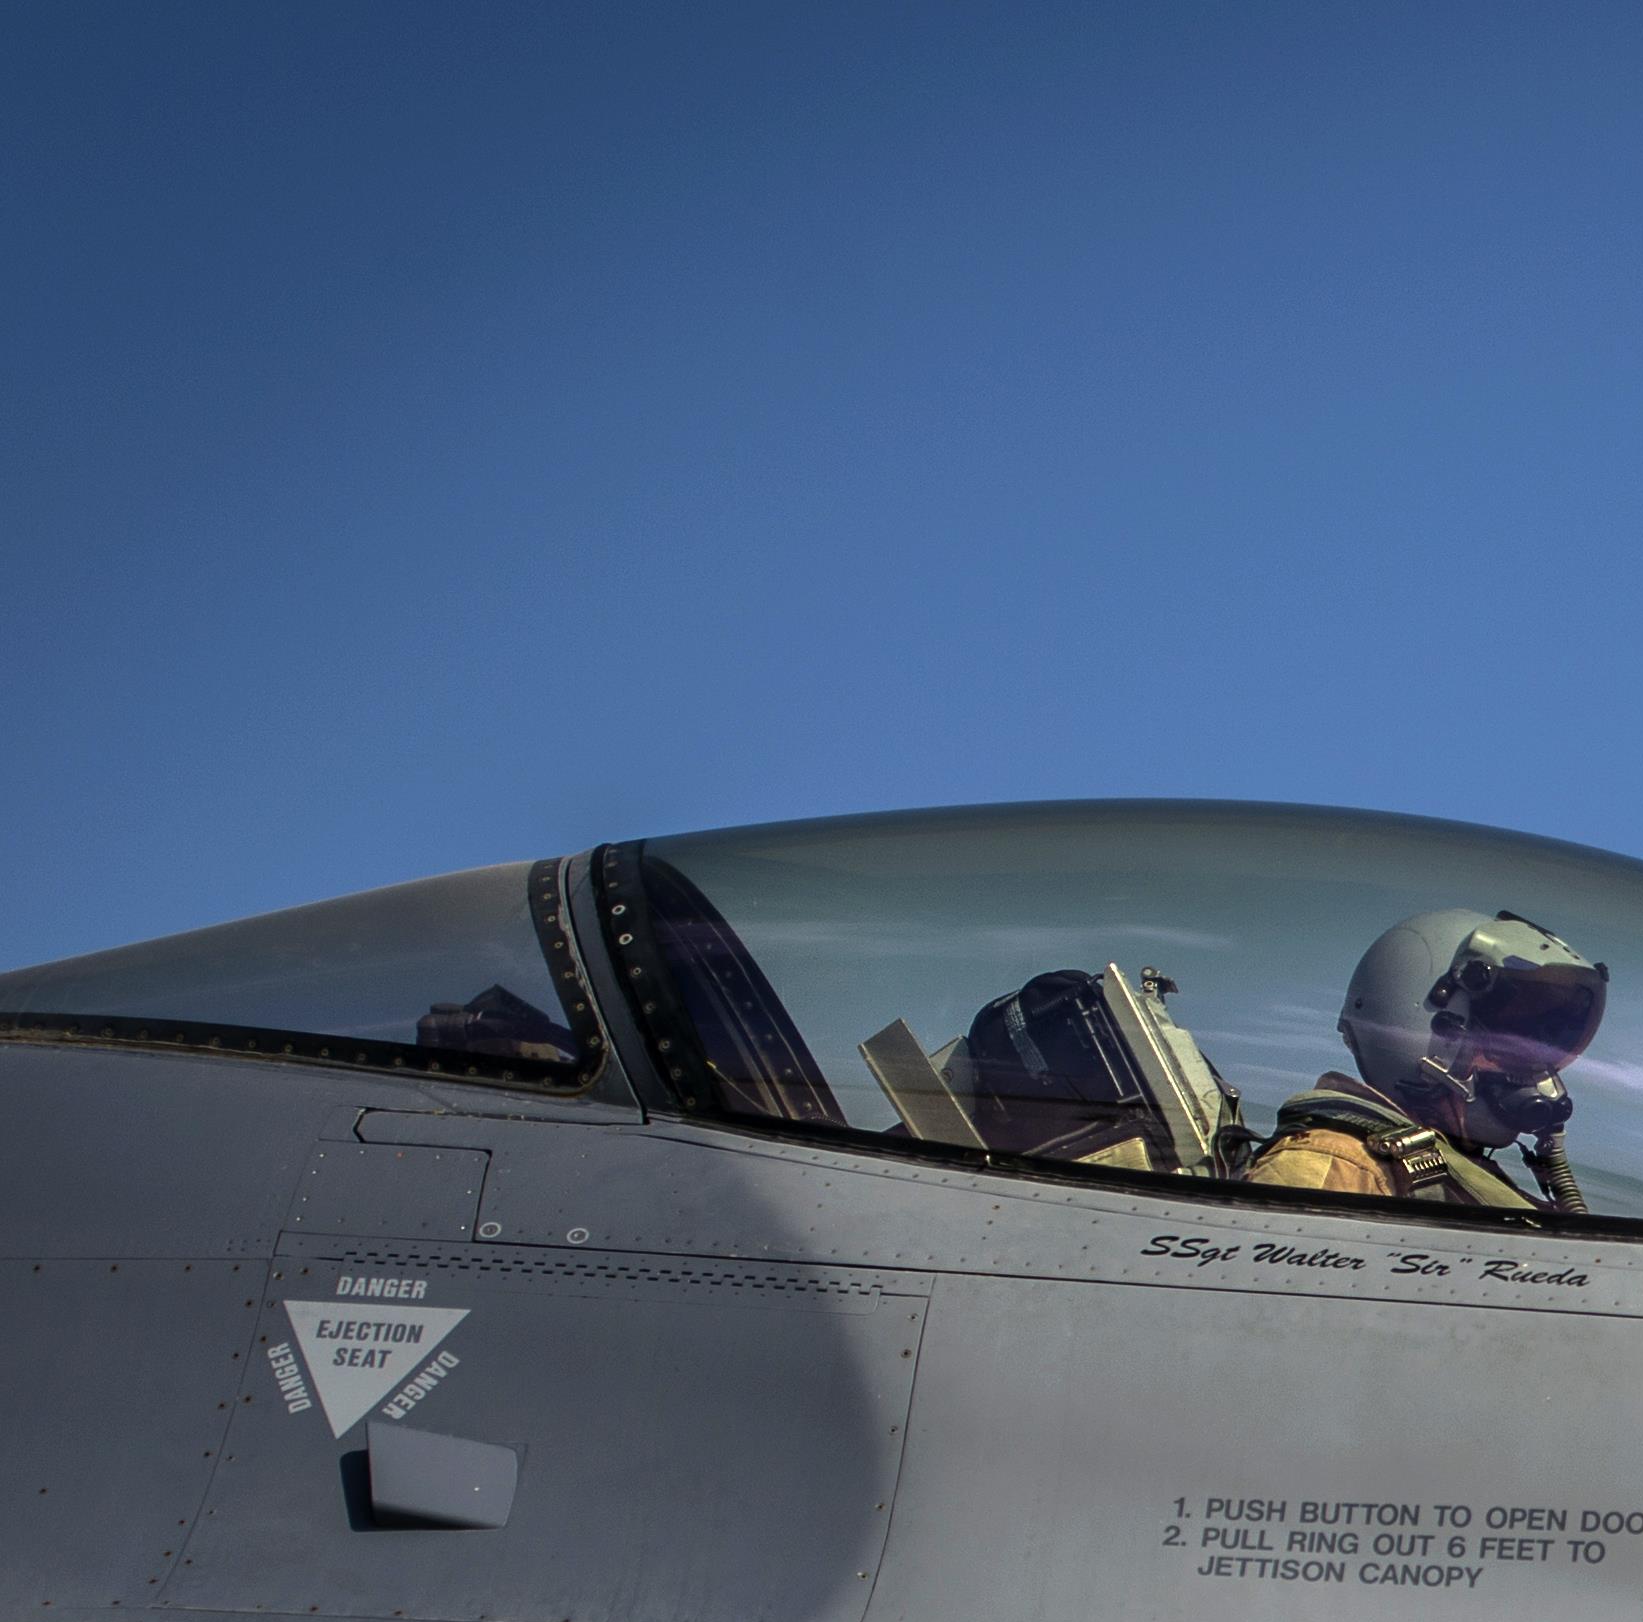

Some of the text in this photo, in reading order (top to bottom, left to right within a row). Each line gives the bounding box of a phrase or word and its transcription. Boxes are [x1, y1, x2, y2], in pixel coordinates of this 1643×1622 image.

[1140, 1236, 1240, 1264] SSgt
[1253, 1242, 1366, 1270] Walter
[1479, 1259, 1590, 1288] Rueda
[336, 1275, 428, 1300] DANGER
[315, 1319, 424, 1345] EJECTION
[332, 1347, 392, 1369] SEAT
[267, 1342, 312, 1415] DANGER
[382, 1350, 460, 1420] DANGER
[1172, 1497, 1191, 1518] 1.
[1205, 1500, 1287, 1522] PUSH
[1300, 1502, 1420, 1527] BUTTON
[1434, 1505, 1472, 1528] TO
[1486, 1506, 1567, 1532] OPEN
[1162, 1526, 1607, 1565] 2. PULL RING OUT 6 FEET TO
[1197, 1557, 1484, 1588] JETTISON CANOPY
